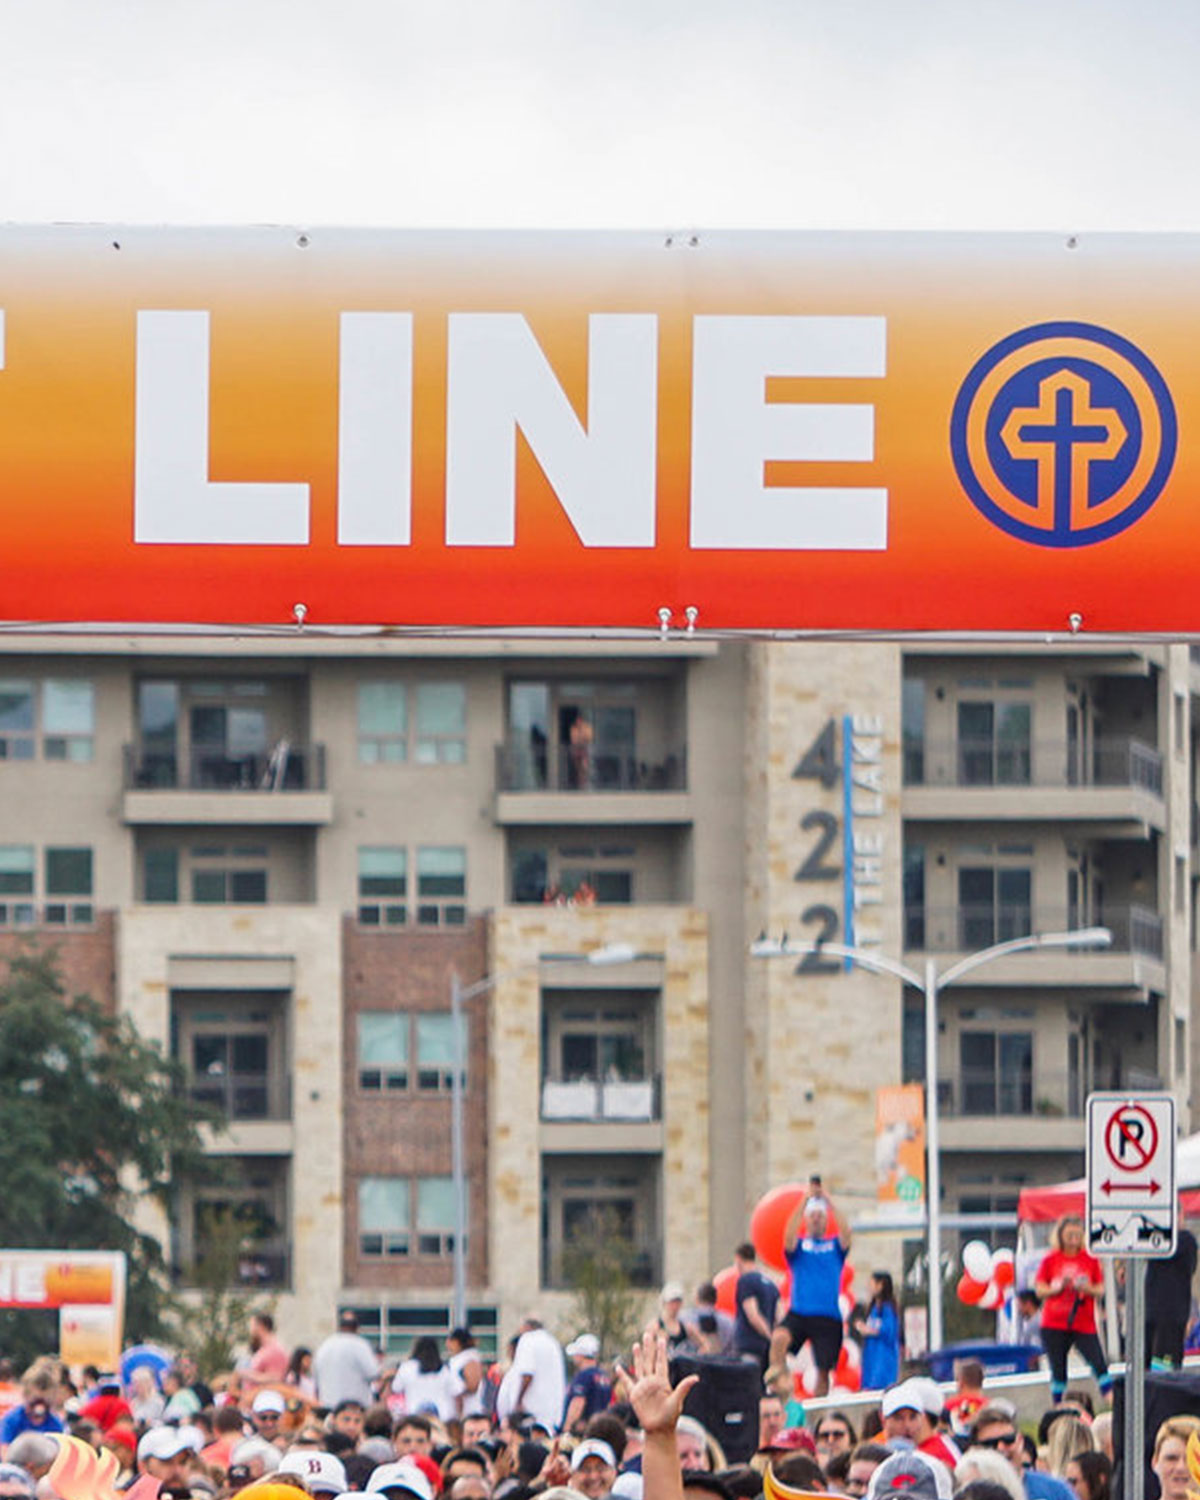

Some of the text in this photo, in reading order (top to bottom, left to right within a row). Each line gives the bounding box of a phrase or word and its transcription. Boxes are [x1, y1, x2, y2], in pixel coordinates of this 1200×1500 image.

[134, 309, 888, 550] LINE
[853, 714, 882, 818] LAKE
[853, 831, 881, 913] THE
